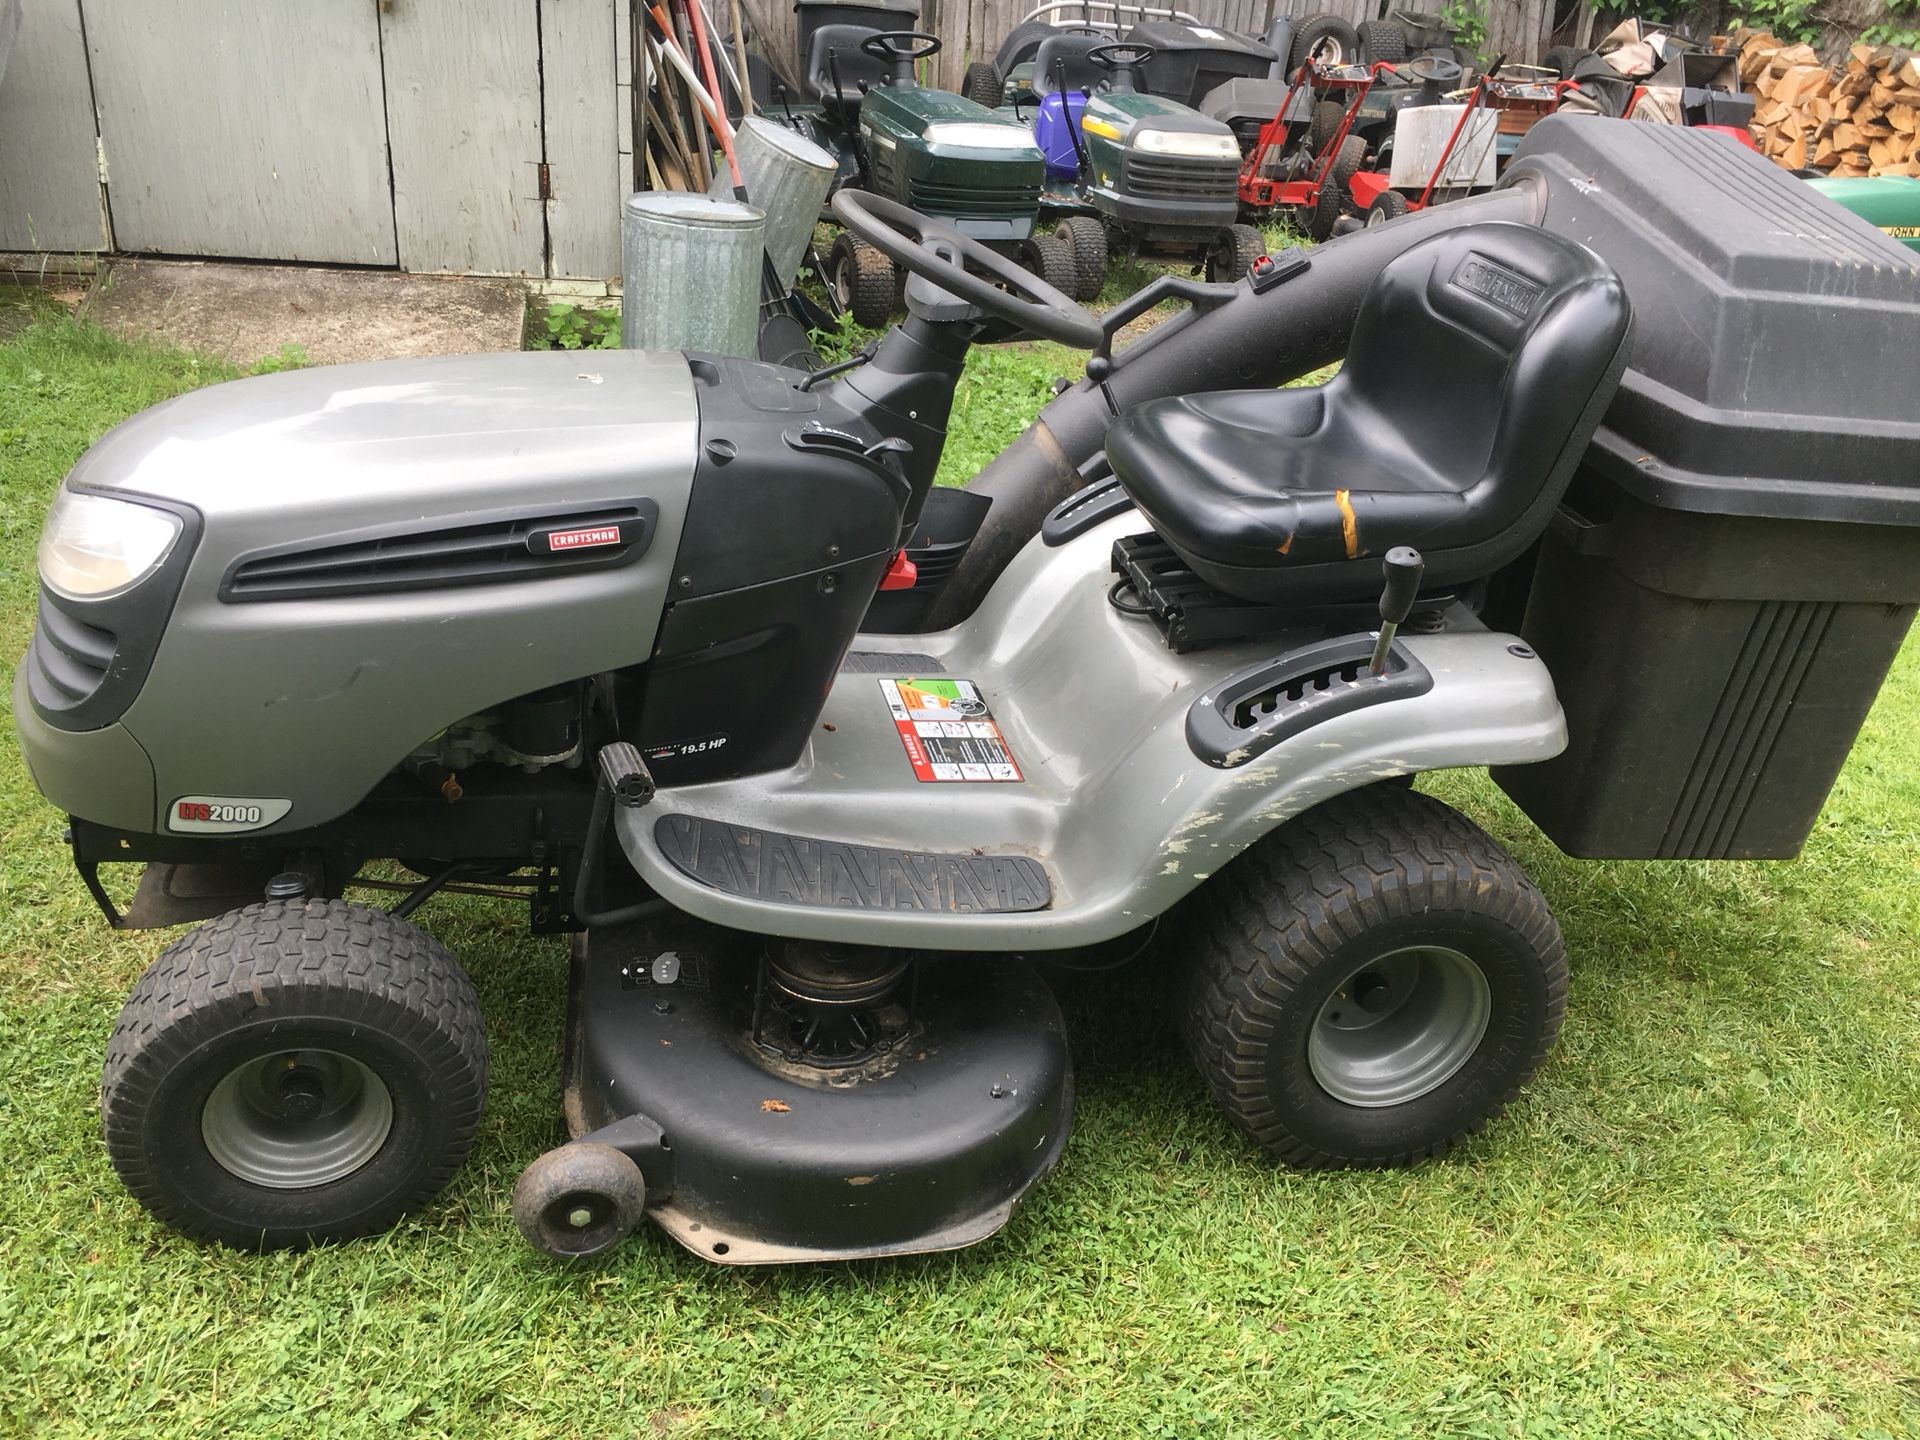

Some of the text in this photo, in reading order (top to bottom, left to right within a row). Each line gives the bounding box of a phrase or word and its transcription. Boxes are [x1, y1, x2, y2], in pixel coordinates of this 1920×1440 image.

[1888, 227, 1915, 238] JOHN
[554, 531, 616, 546] CRAFTSMAN
[681, 737, 727, 755] 19.5 HP
[179, 802, 261, 823] LTS2000
